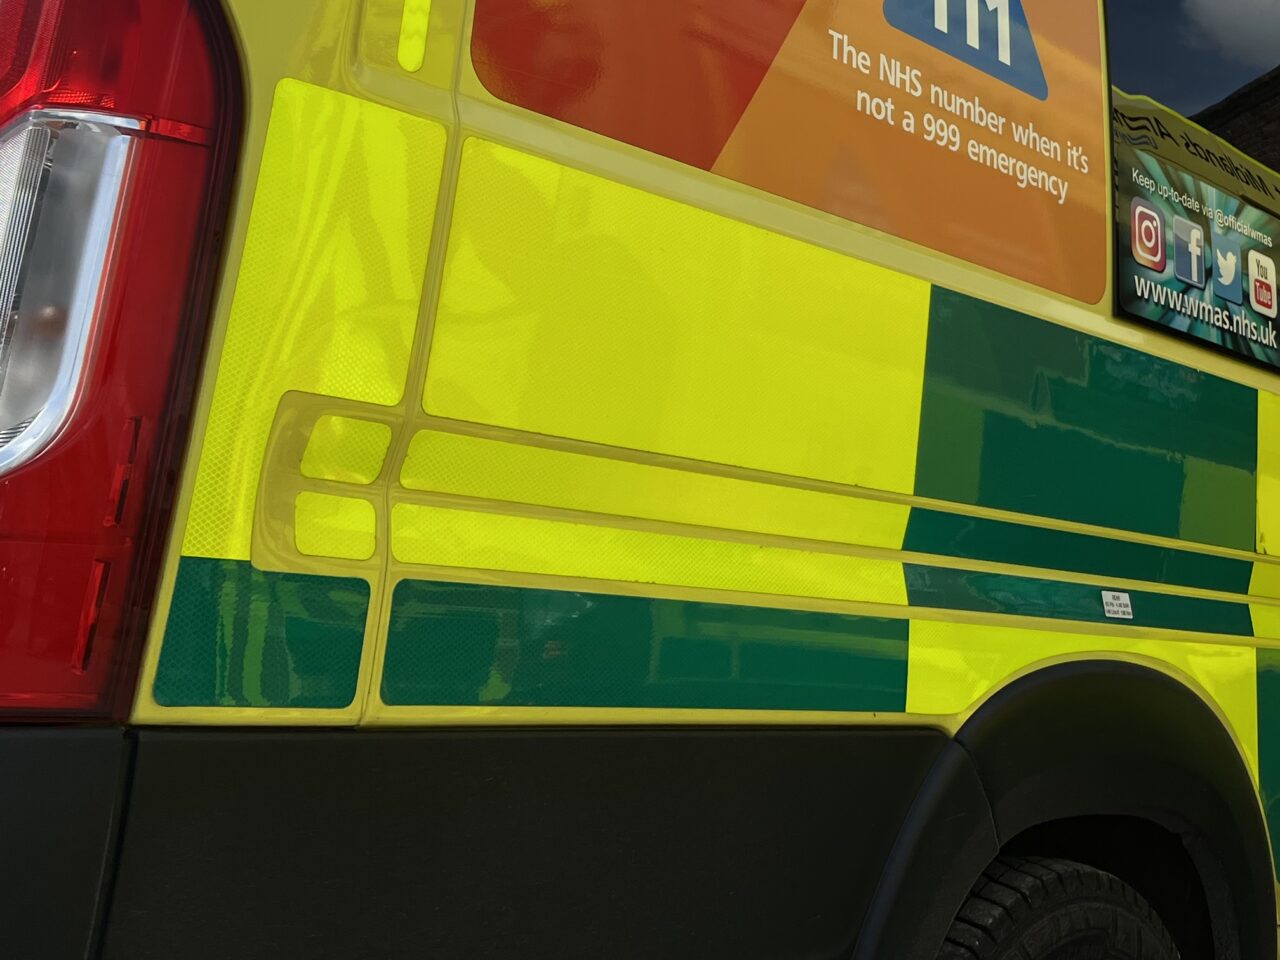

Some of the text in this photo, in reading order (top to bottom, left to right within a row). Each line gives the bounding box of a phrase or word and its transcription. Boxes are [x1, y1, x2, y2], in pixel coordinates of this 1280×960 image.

[828, 29, 871, 74] The
[879, 53, 922, 97] NHS
[930, 83, 1006, 136] number
[1012, 121, 1061, 162] when
[1066, 141, 1089, 174] it's
[857, 89, 1069, 205] not a 999 emergency
[1132, 168, 1273, 248] Keep up-to-date via @officialwmas
[1134, 276, 1278, 349] www.wmas.nhs.uk
